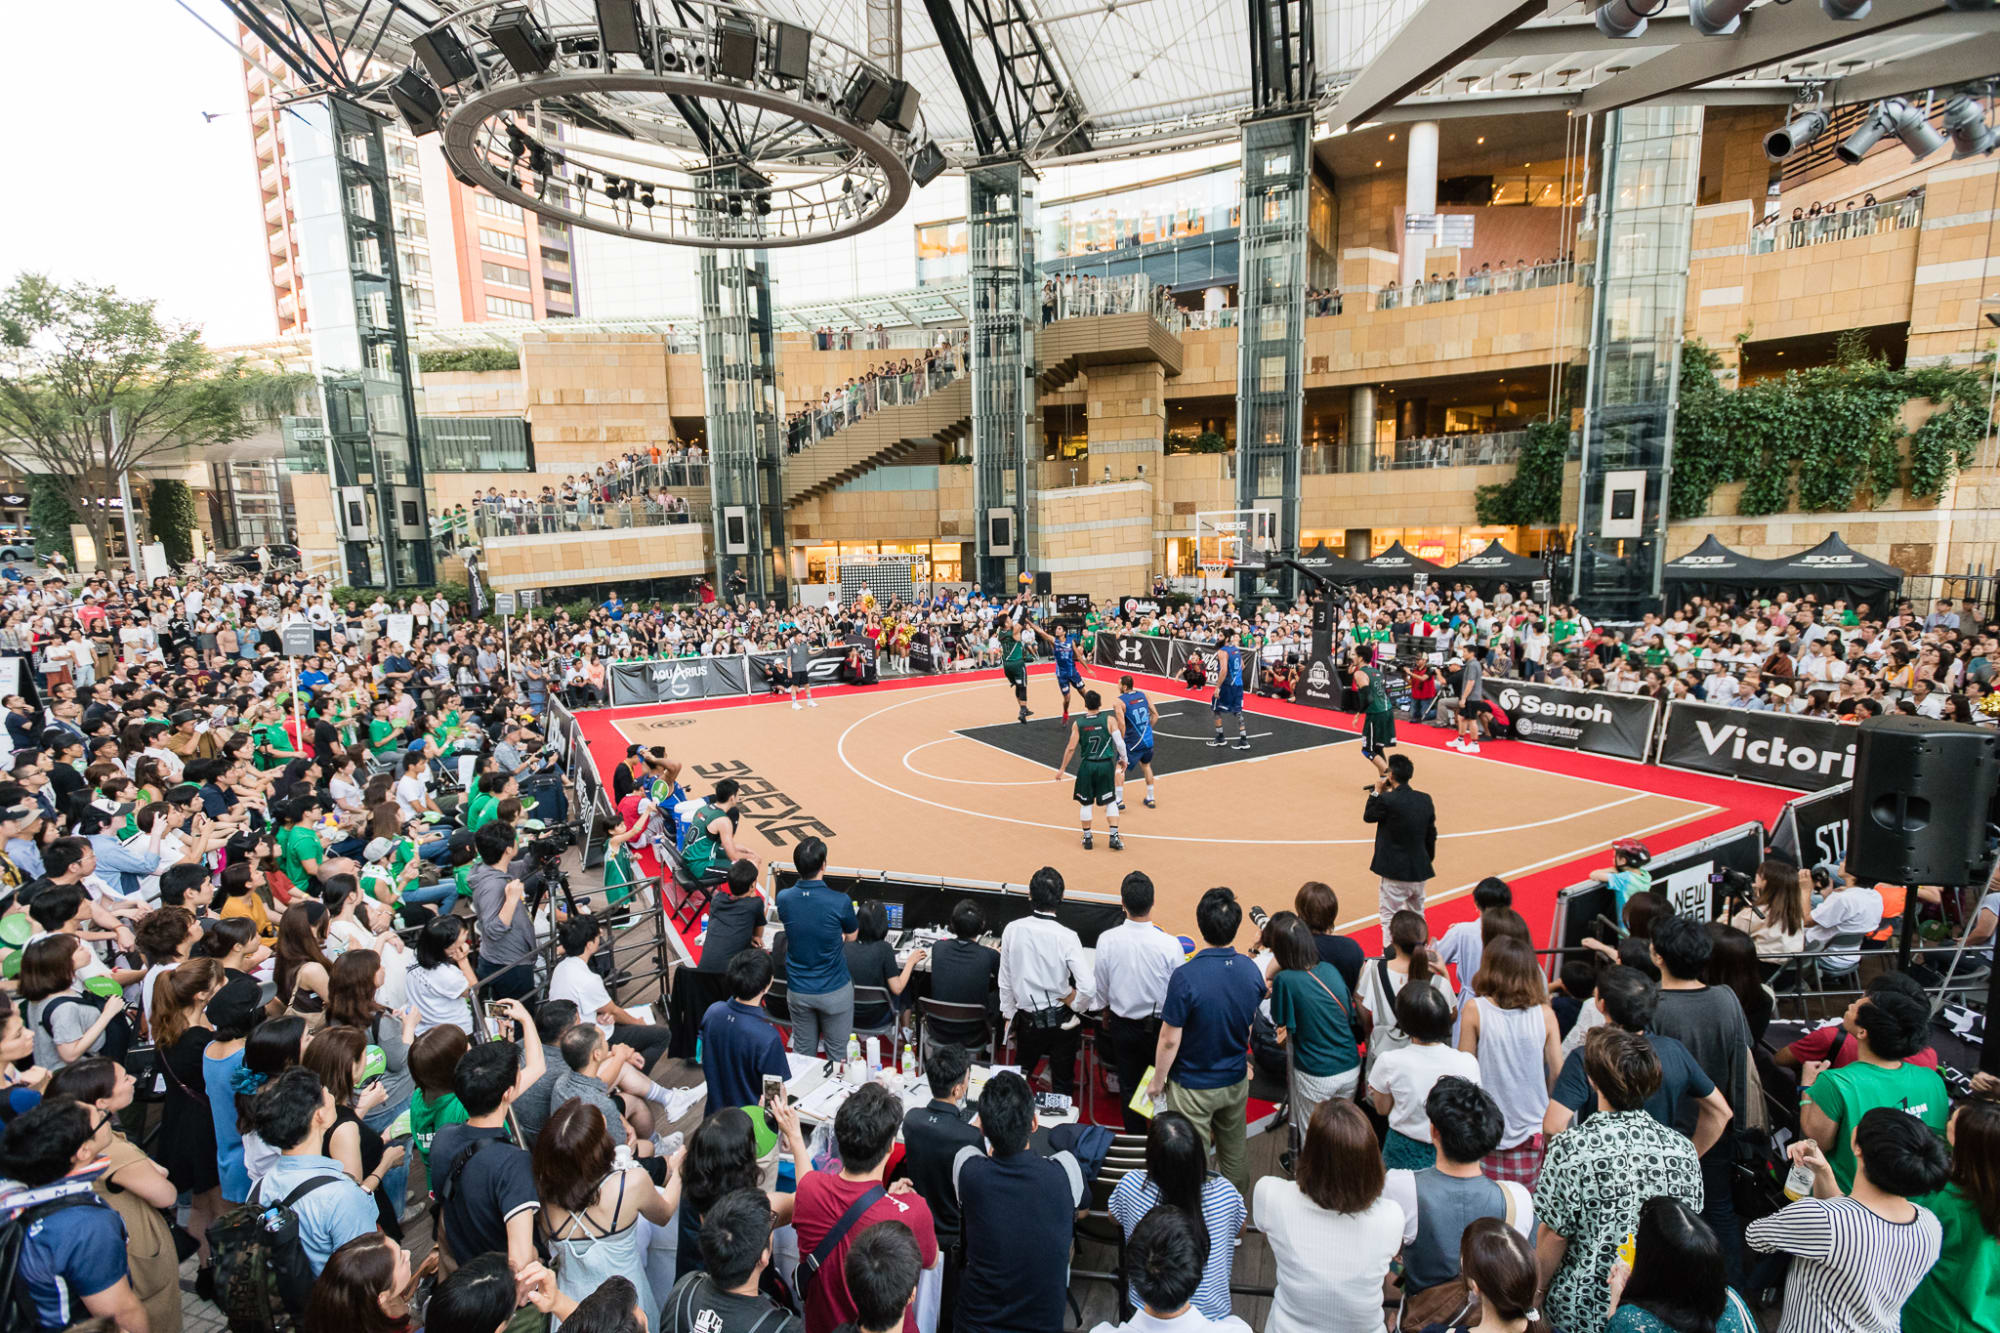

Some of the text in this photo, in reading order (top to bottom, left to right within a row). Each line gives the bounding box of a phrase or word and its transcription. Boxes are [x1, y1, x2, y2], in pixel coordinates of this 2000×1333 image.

[652, 661, 708, 686] AQUARIUS
[1233, 657, 1241, 670] 6
[1132, 706, 1149, 725] 12
[1520, 694, 1613, 725] Senoh
[1088, 735, 1102, 754] 7
[1674, 881, 1706, 913] NEW
